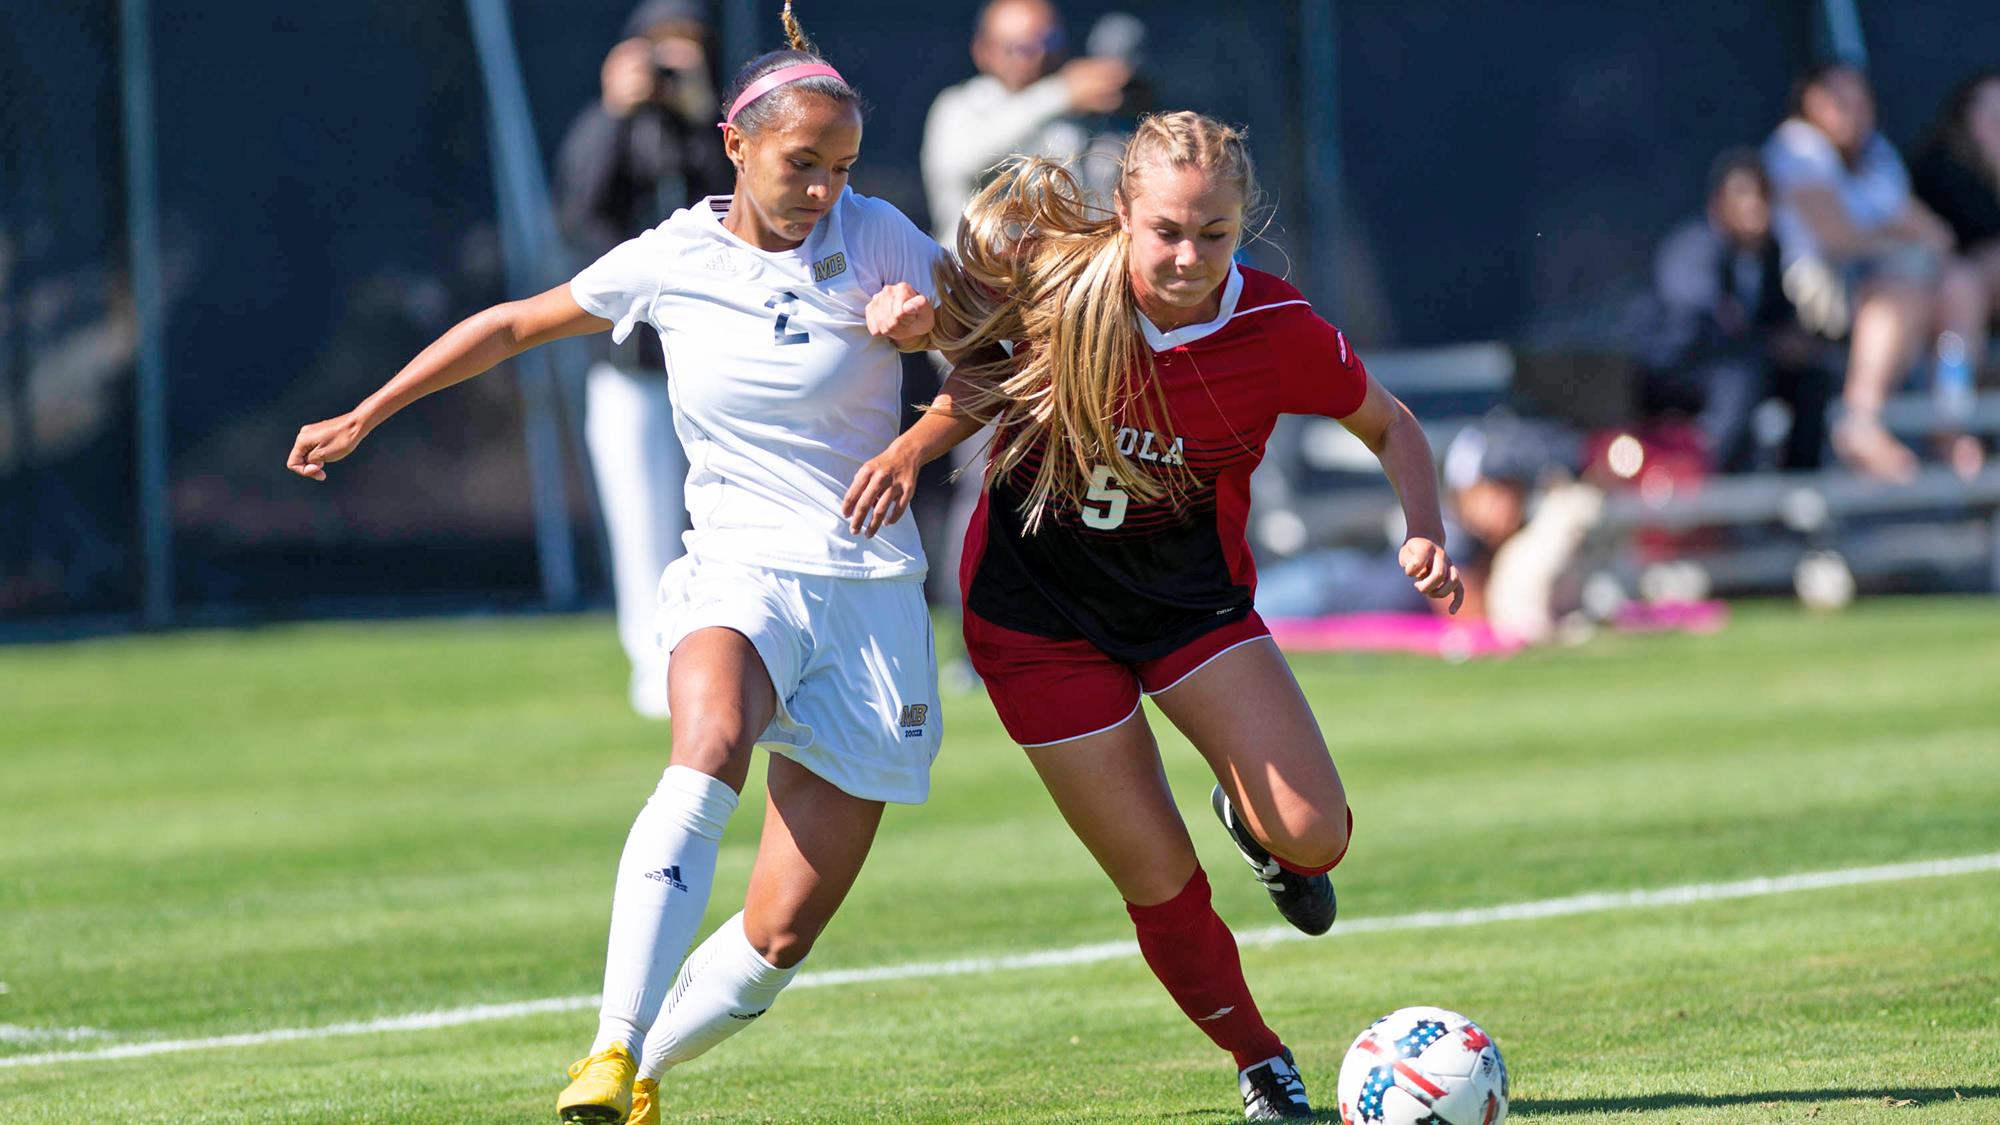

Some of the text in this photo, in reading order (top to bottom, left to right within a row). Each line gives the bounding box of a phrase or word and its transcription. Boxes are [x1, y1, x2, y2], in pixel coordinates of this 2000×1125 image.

[812, 251, 846, 282] MB
[764, 291, 810, 346] 2
[1111, 424, 1184, 466] OLA
[1081, 464, 1129, 530] 5
[900, 703, 928, 727] MB
